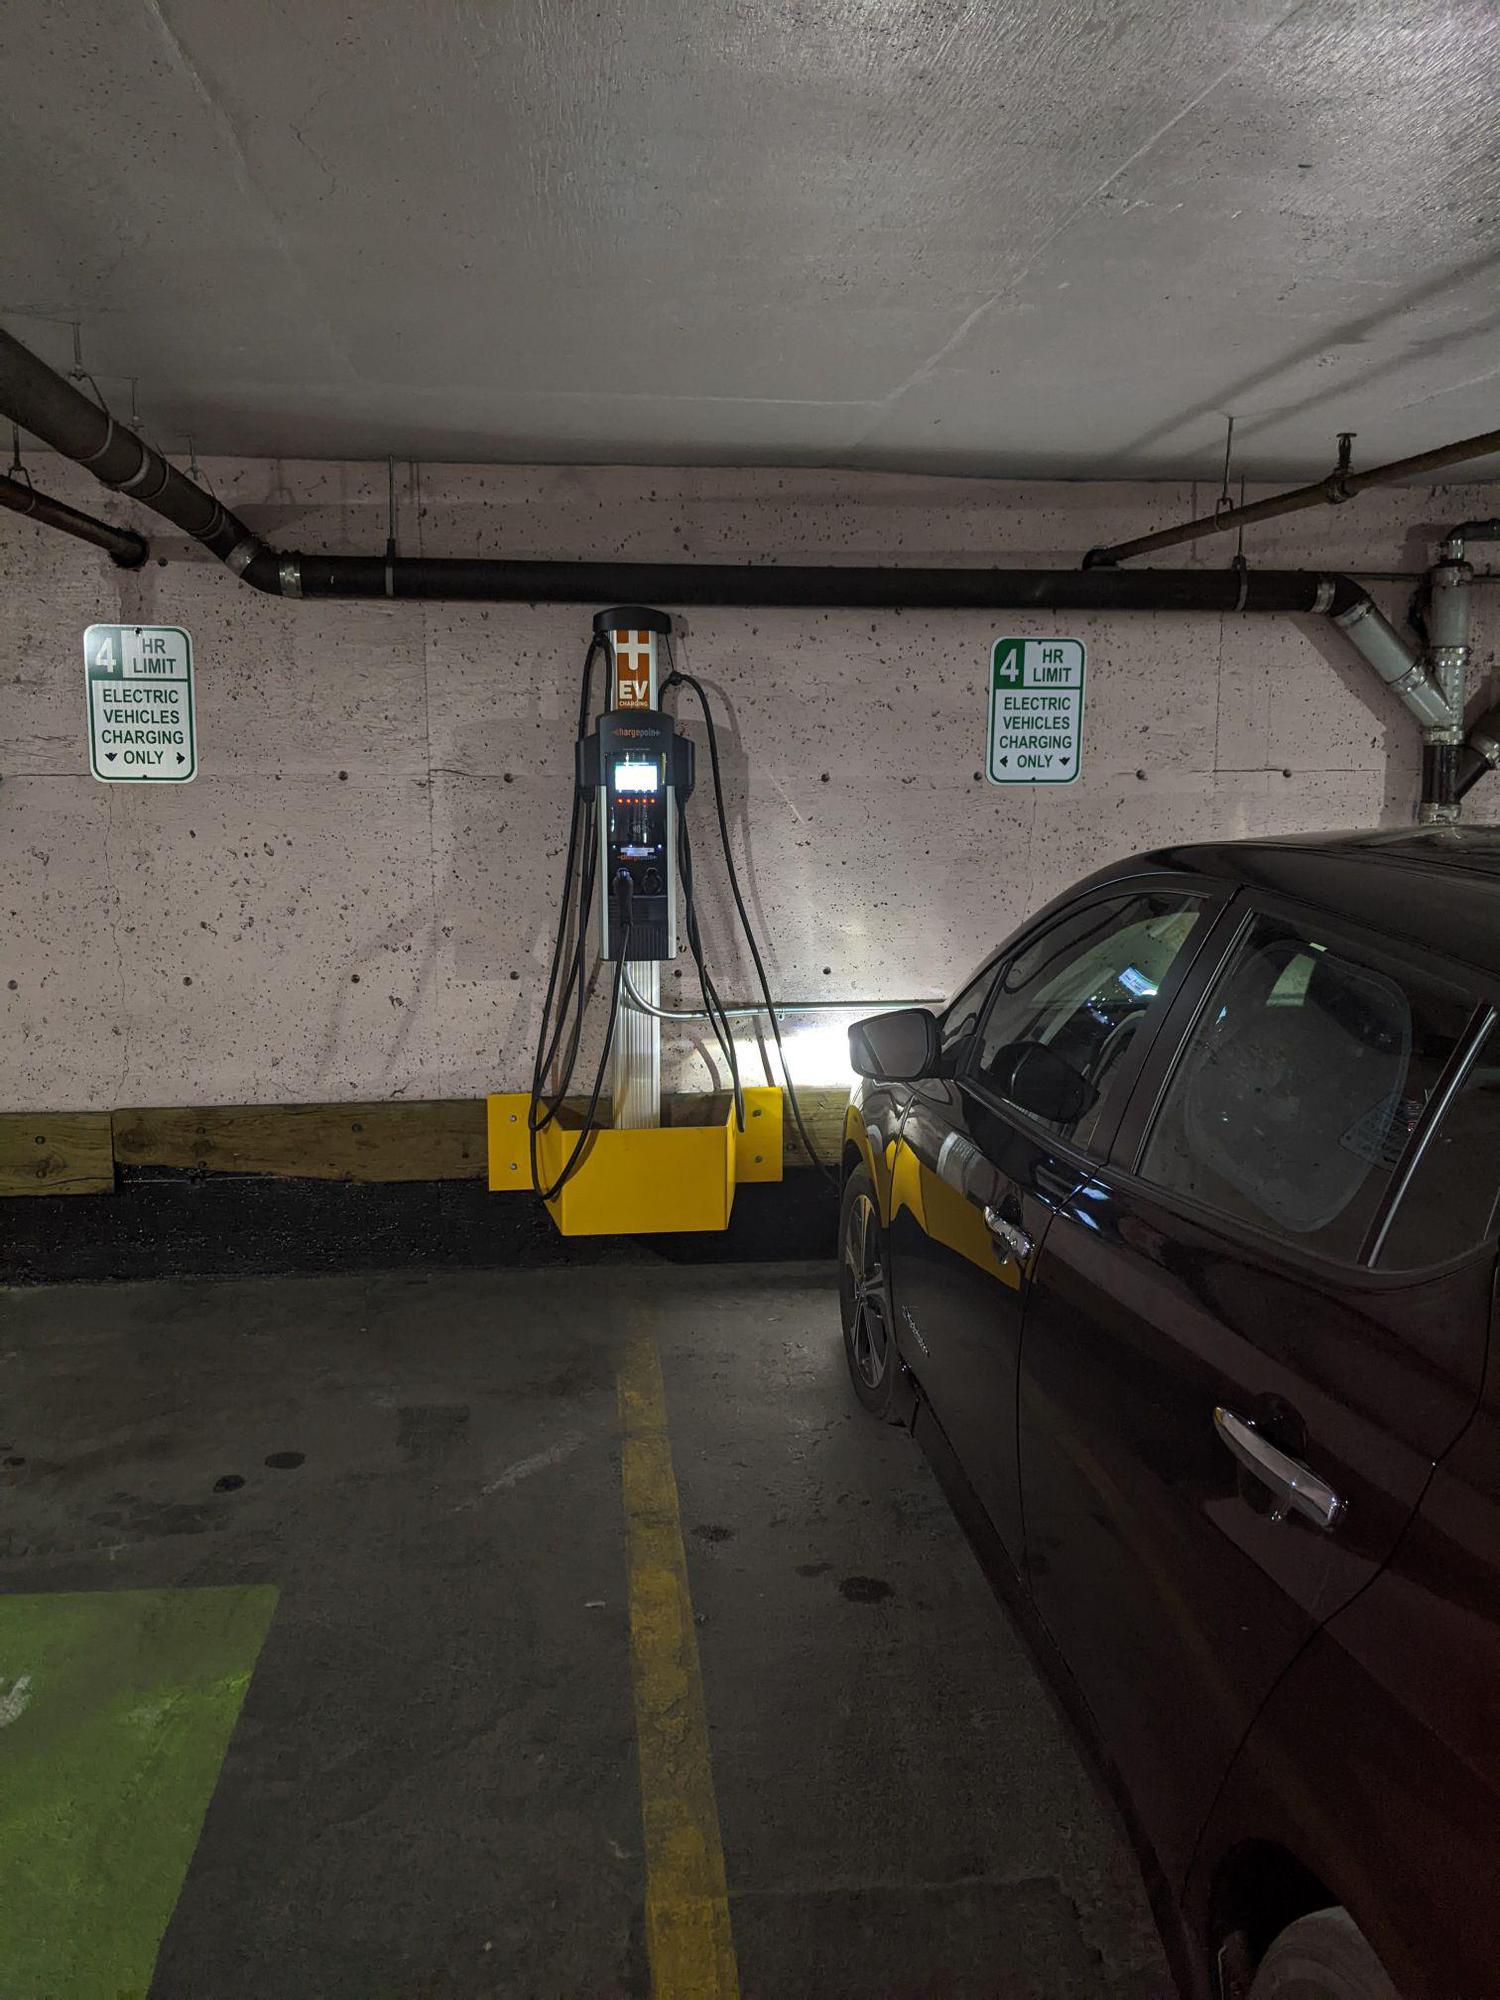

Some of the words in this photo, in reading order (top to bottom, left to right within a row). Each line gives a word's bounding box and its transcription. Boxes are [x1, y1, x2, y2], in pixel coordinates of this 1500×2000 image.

[142, 638, 166, 654] HR
[95, 637, 116, 673] 4
[1042, 649, 1064, 664] HR
[133, 658, 176, 674] LIMIT
[999, 648, 1019, 682] 4
[1033, 668, 1072, 682] LIMIT
[103, 689, 179, 704] ELECTRIC
[619, 680, 648, 700] EV
[619, 700, 648, 708] CHARGING
[1004, 697, 1071, 711] ELECTRIC
[103, 709, 180, 724] VEHICLES
[1003, 716, 1070, 730] VEHICLES
[101, 730, 184, 745] CHARGING
[999, 735, 1072, 749] CHARGING
[123, 751, 164, 765] ONLY
[1017, 755, 1053, 768] ONLY
